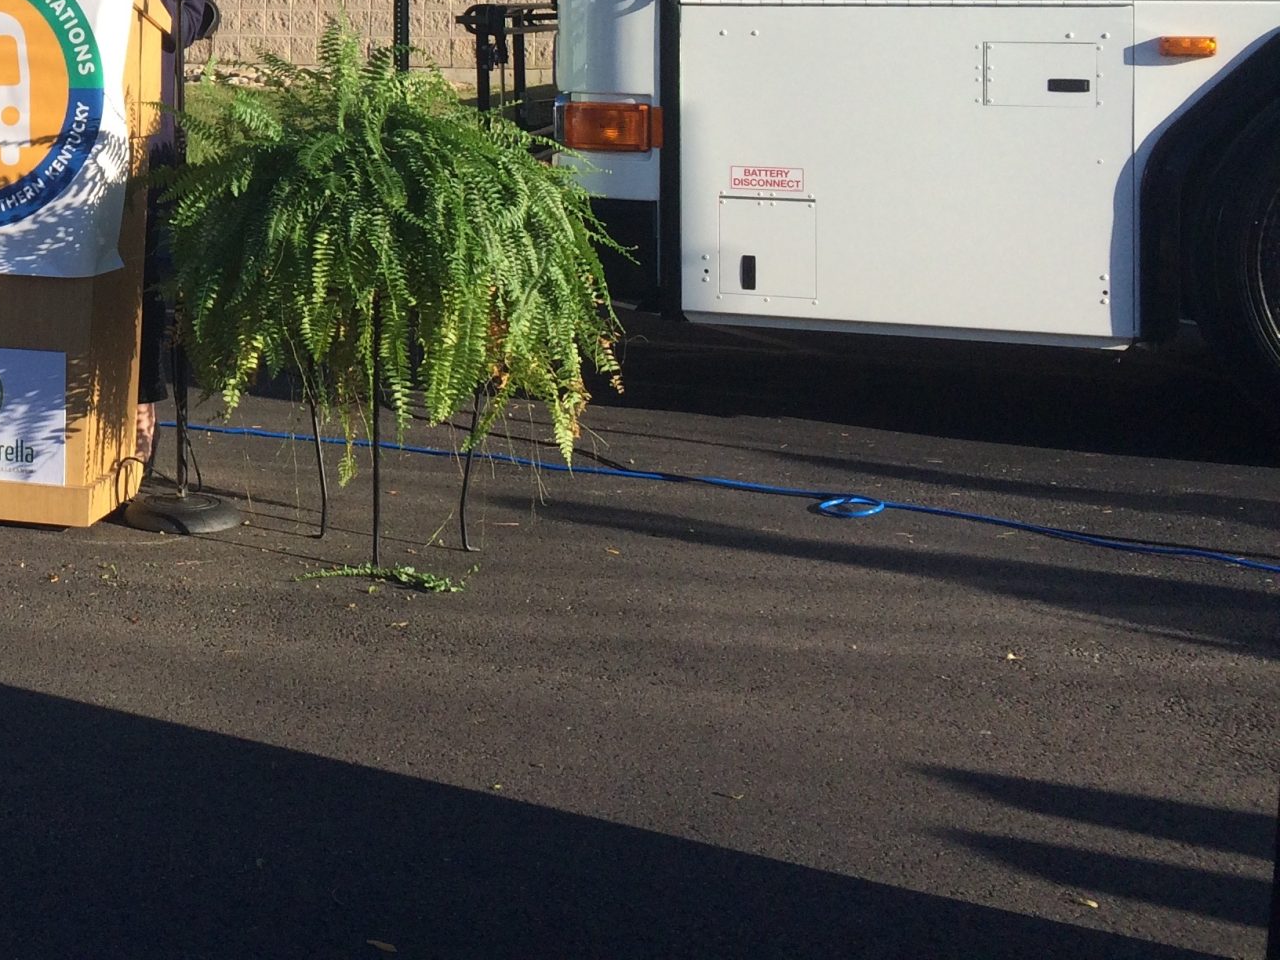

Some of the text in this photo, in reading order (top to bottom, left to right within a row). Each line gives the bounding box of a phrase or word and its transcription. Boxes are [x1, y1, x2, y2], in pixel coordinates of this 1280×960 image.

[45, 101, 90, 180] KENTUCKY
[743, 168, 791, 179] BATTERY
[733, 178, 801, 189] DISCONNECT
